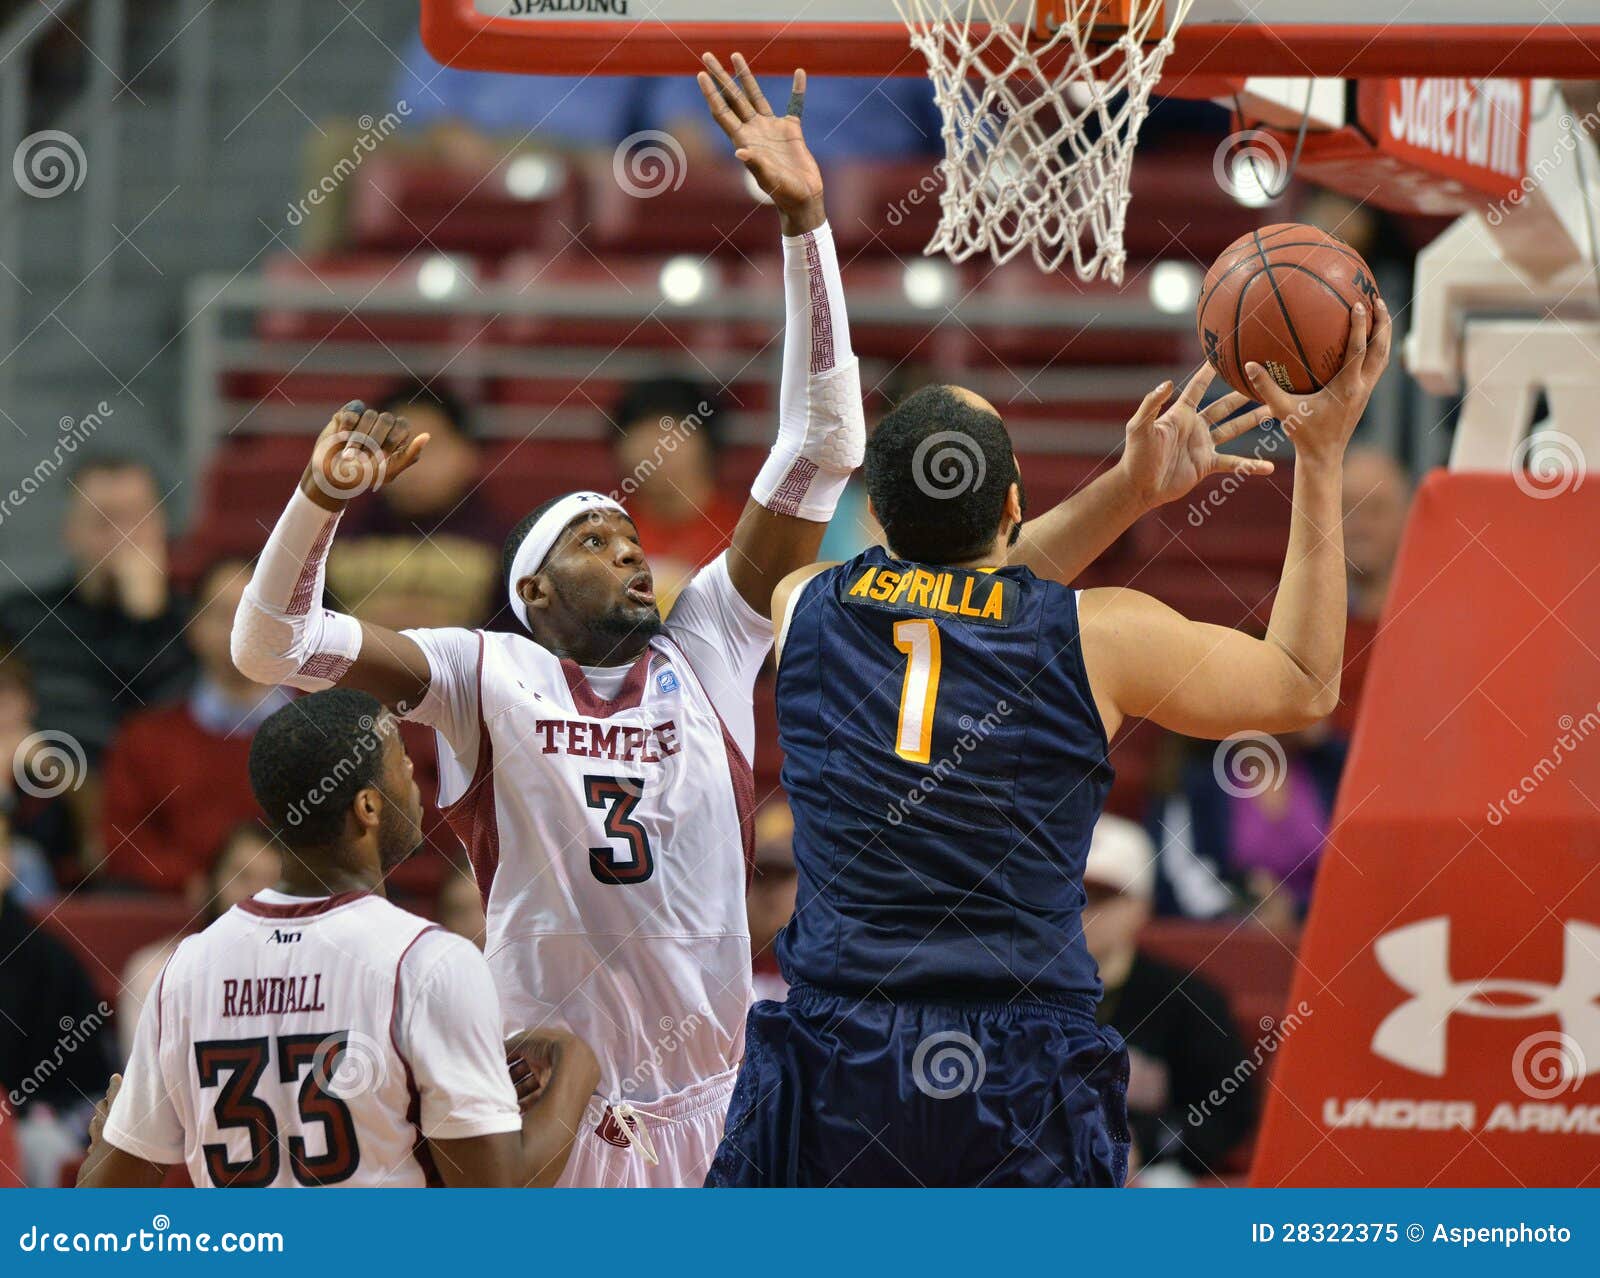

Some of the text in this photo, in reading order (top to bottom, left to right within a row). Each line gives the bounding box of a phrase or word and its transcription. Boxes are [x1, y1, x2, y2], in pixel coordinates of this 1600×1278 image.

[849, 566, 1003, 620] ASPRILLA
[893, 618, 941, 764] 1
[535, 719, 682, 763] TEMPLE
[583, 774, 654, 885] 3
[222, 974, 325, 1018] RANDALL
[194, 1029, 360, 1187] 33
[1323, 1098, 1476, 1129] UNDER
